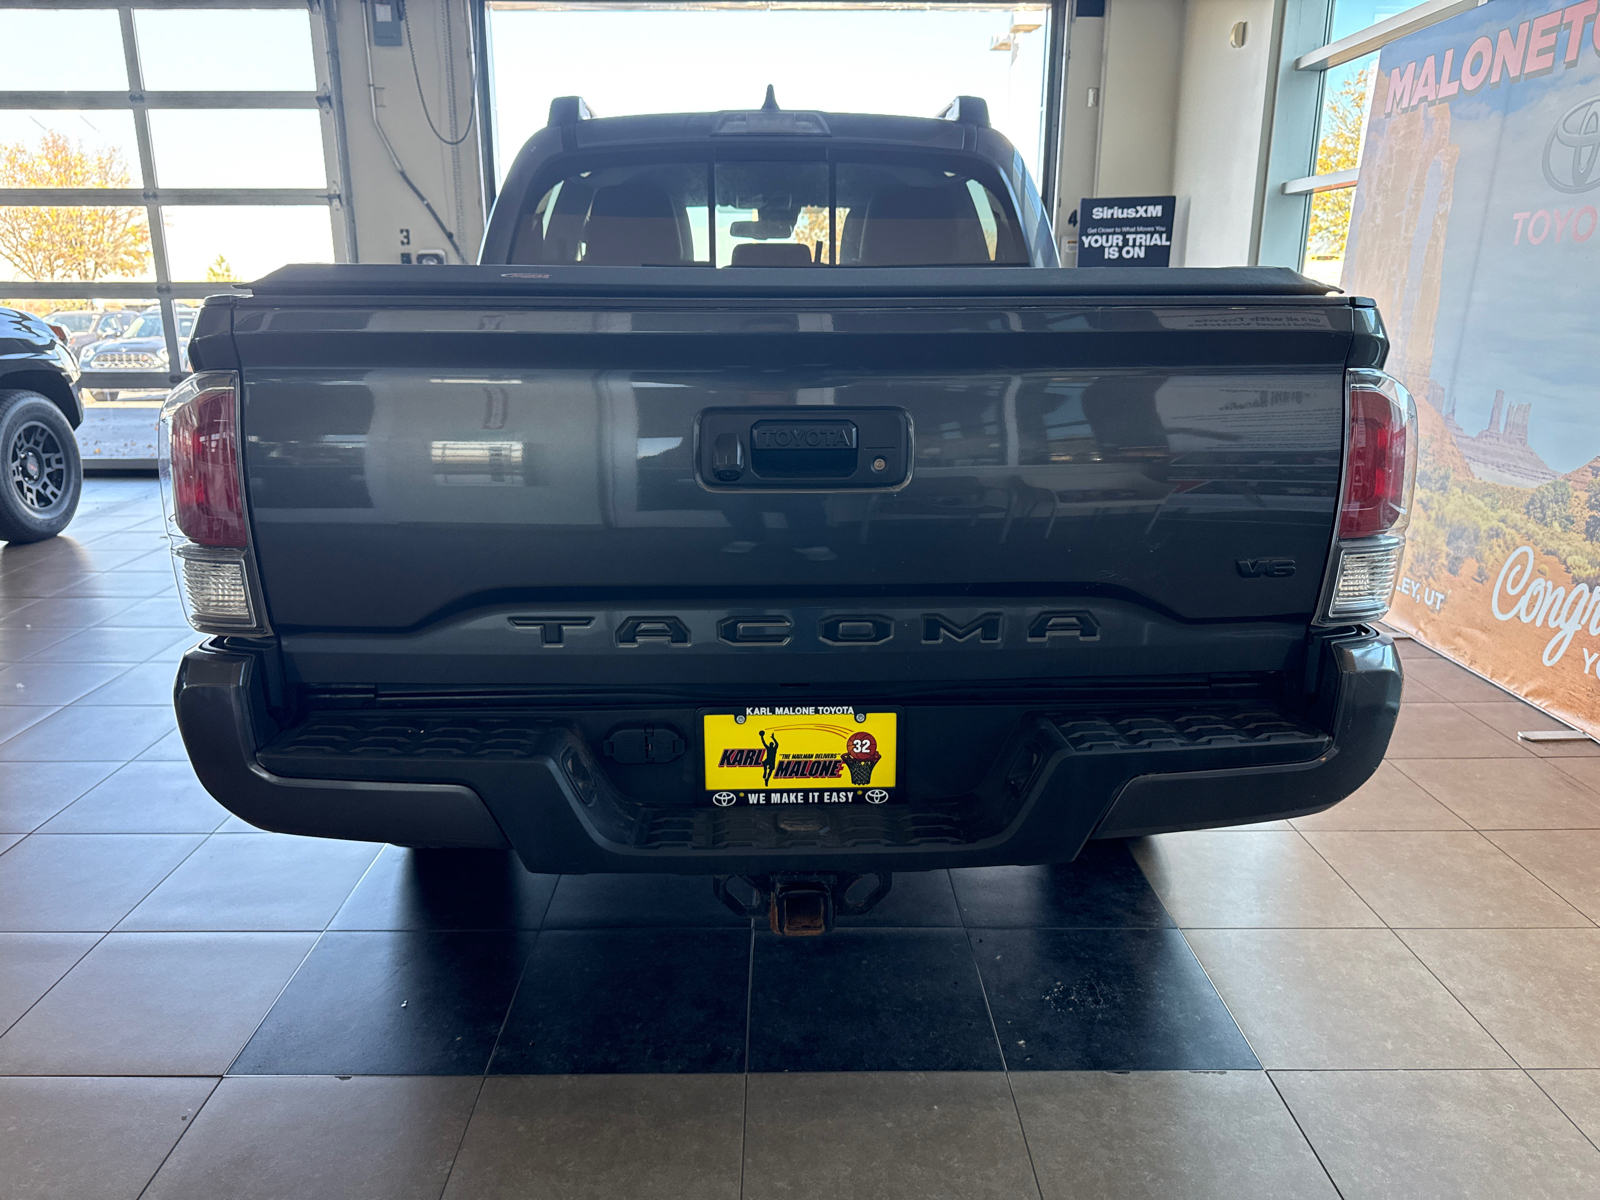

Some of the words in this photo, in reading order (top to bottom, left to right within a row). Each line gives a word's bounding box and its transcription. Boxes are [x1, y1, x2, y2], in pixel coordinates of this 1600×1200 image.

[1384, 0, 1600, 118] MALONET
[1067, 209, 1078, 227] 4
[1092, 205, 1162, 219] SiriusXM
[400, 228, 411, 246] 3
[1081, 234, 1123, 248] YOUR
[1126, 233, 1171, 246] TRIAL
[1104, 247, 1119, 259] IS
[1122, 246, 1145, 259] ON
[761, 429, 850, 447] TOYOTA
[1236, 558, 1296, 578] V6
[1396, 576, 1420, 603] EY,
[1424, 587, 1445, 610] UT
[508, 608, 1102, 648] TACOMA
[746, 707, 773, 715] KARL
[775, 707, 815, 715] MALONE
[818, 706, 854, 714] TOYOTA
[853, 739, 871, 753] 32
[718, 748, 766, 767] KARL
[773, 760, 844, 779] MALONE
[748, 793, 766, 804] WE
[770, 793, 804, 804] MAKE
[808, 792, 820, 803] IT
[824, 792, 854, 803] EASY
